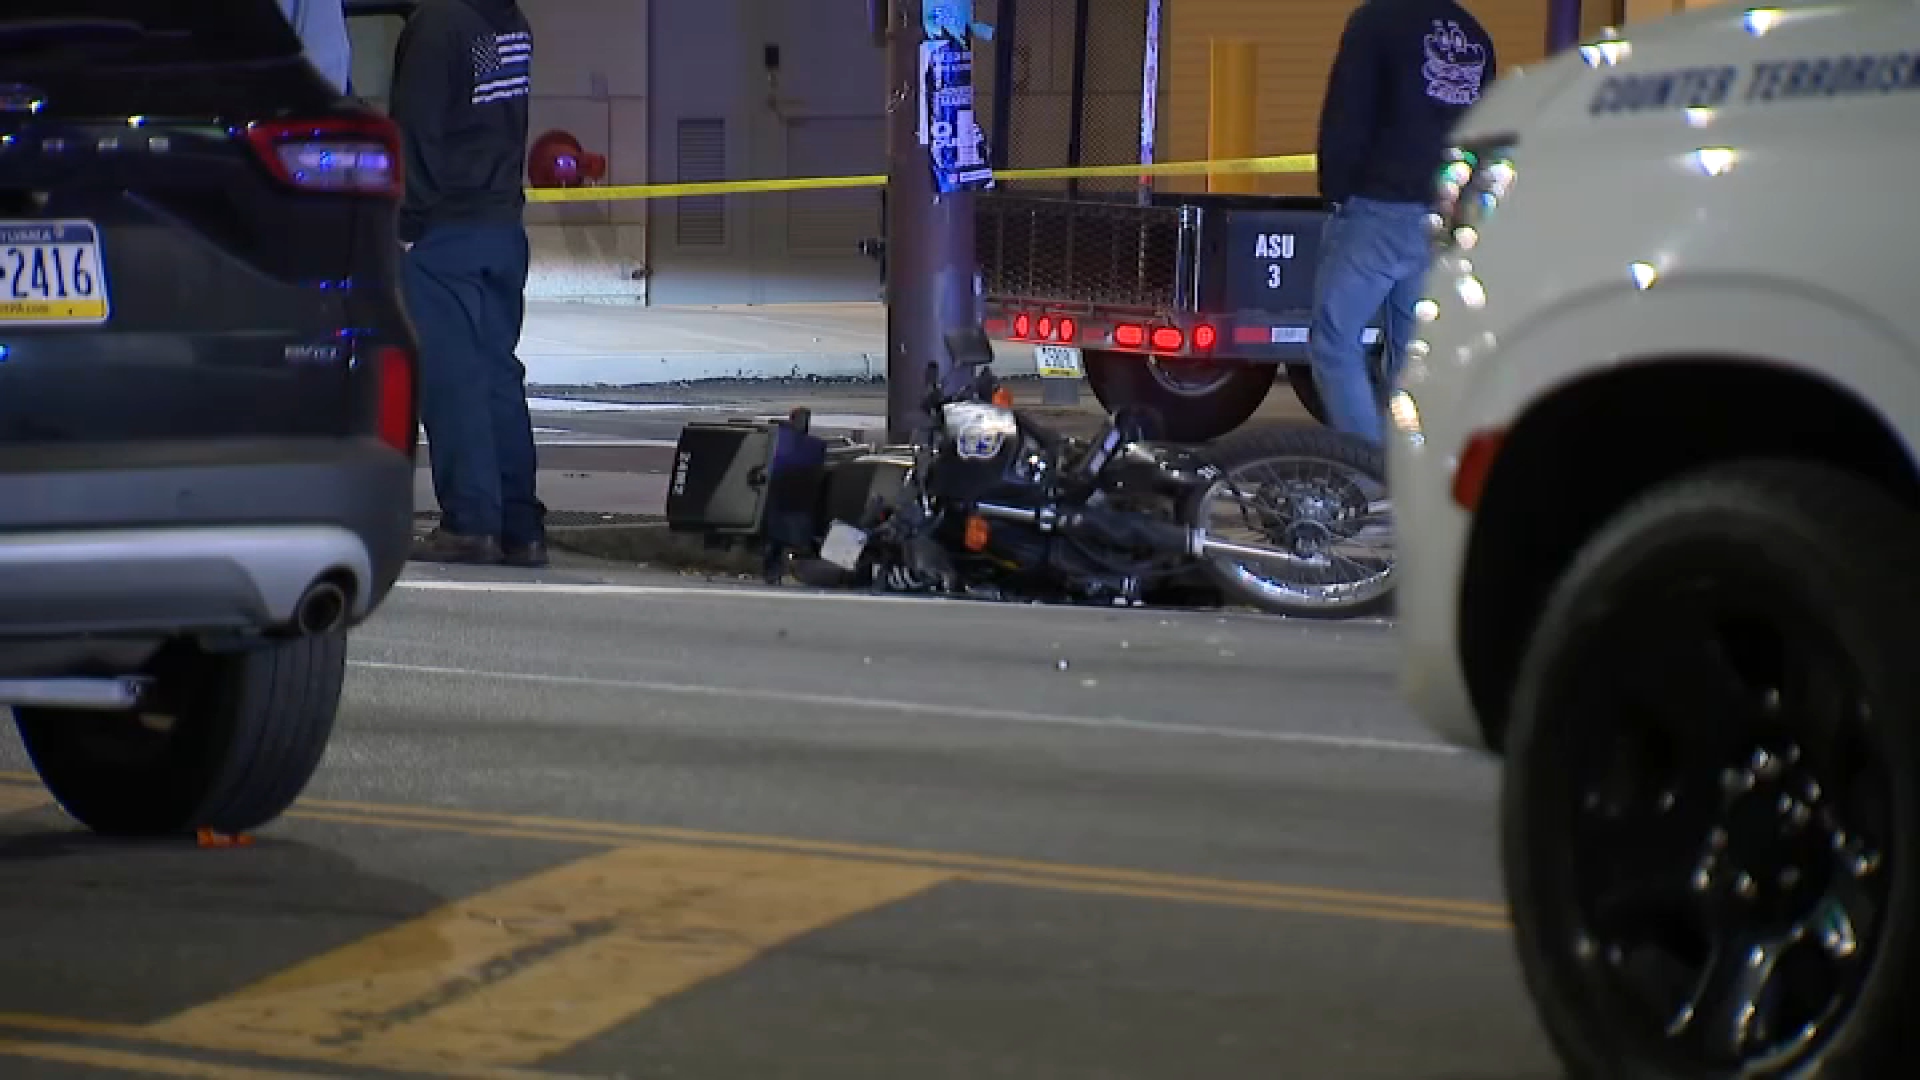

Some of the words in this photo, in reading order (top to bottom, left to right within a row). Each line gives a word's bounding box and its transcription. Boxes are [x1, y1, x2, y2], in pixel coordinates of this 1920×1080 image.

[1589, 65, 1738, 115] COUNTER
[1255, 233, 1295, 258] ASU
[1267, 263, 1281, 288] 3
